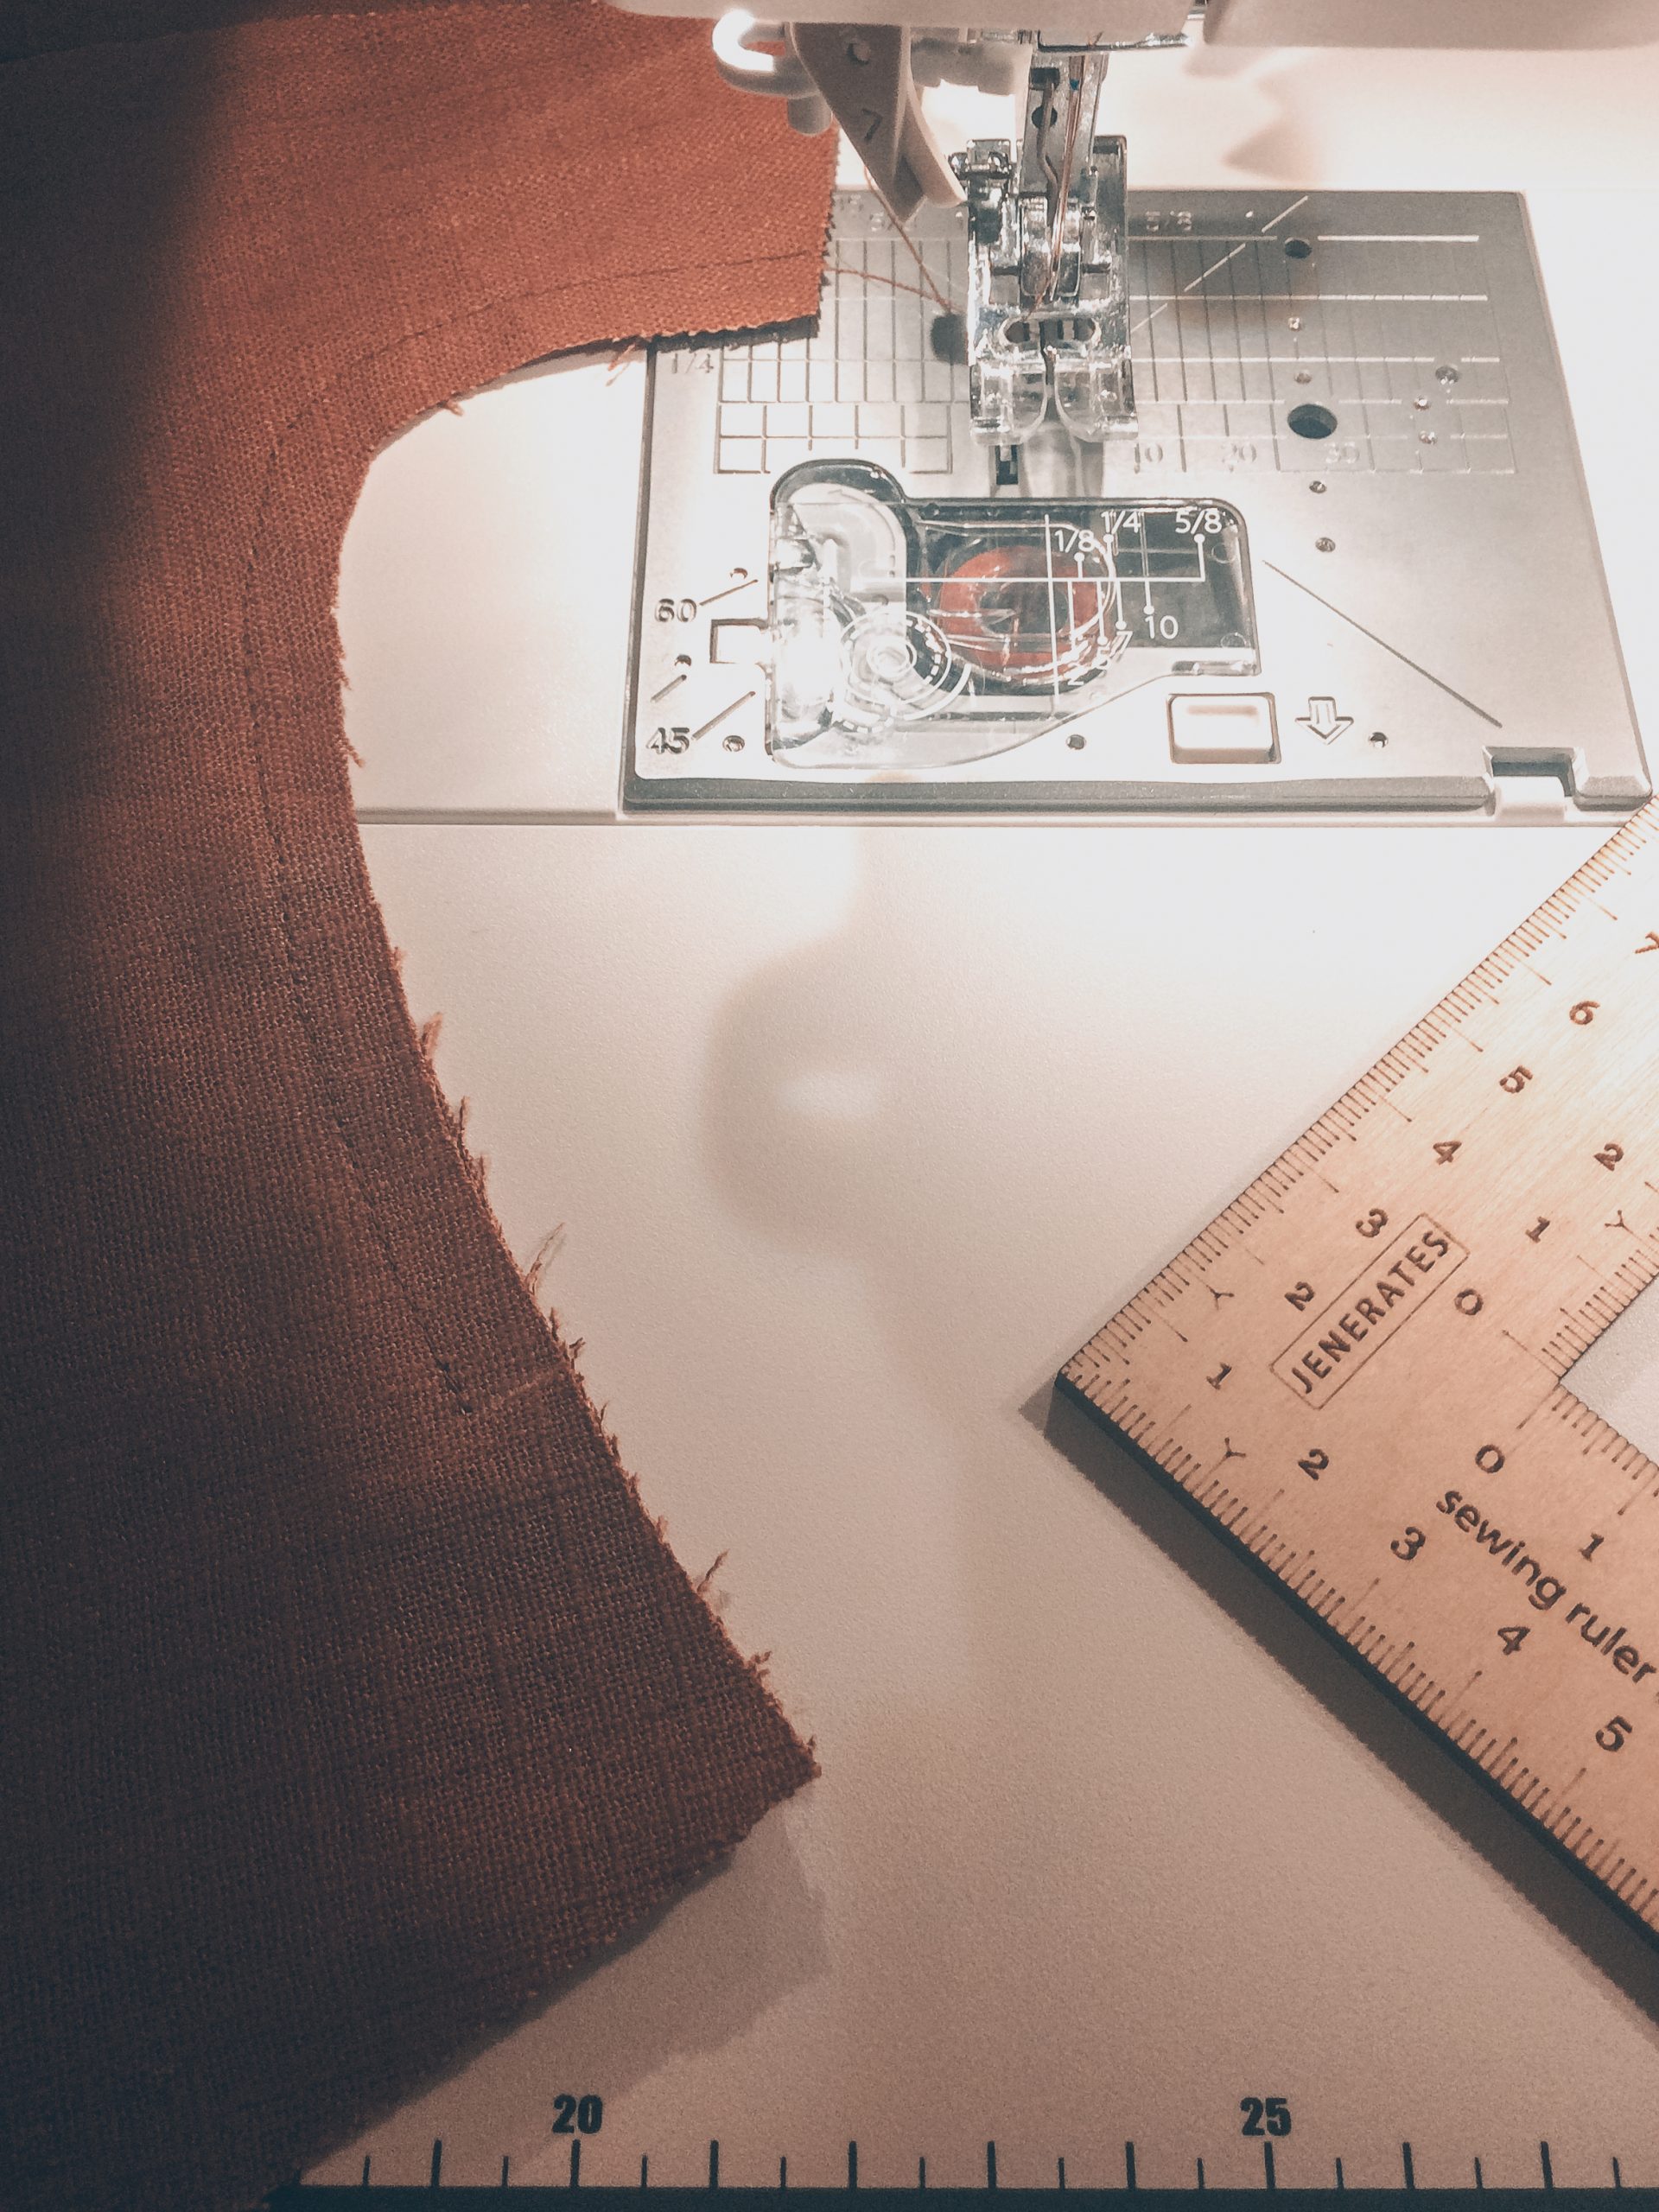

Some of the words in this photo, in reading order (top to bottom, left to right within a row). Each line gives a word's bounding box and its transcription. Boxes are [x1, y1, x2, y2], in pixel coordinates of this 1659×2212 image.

[1101, 511, 1141, 534] 1/4
[1175, 509, 1223, 534] 5/8
[1054, 529, 1096, 553] 1/8
[654, 598, 697, 623] 60
[1145, 615, 1179, 639] 10
[645, 727, 690, 755] 45
[1568, 1000, 1601, 1026] 6
[1499, 1065, 1534, 1095] 5
[1432, 1140, 1463, 1166] 4
[1593, 1142, 1624, 1172] 2
[1355, 1207, 1389, 1238] 3
[1525, 1215, 1551, 1243] 1
[1284, 1281, 1316, 1312] 2
[1453, 1288, 1484, 1316] 0
[1291, 1230, 1449, 1395] JENERATES
[1206, 1362, 1233, 1390] 1
[1297, 1448, 1331, 1481] 2
[1474, 1444, 1506, 1474] 0
[1389, 1526, 1427, 1561] 3
[1578, 1533, 1605, 1563] 1
[1435, 1491, 1568, 1611] sewing
[1565, 1602, 1658, 1684] ruler
[1497, 1624, 1531, 1656] 4
[1594, 1715, 1634, 1752] 5
[551, 2093, 604, 2134] 20
[1239, 2096, 1293, 2136] 25
